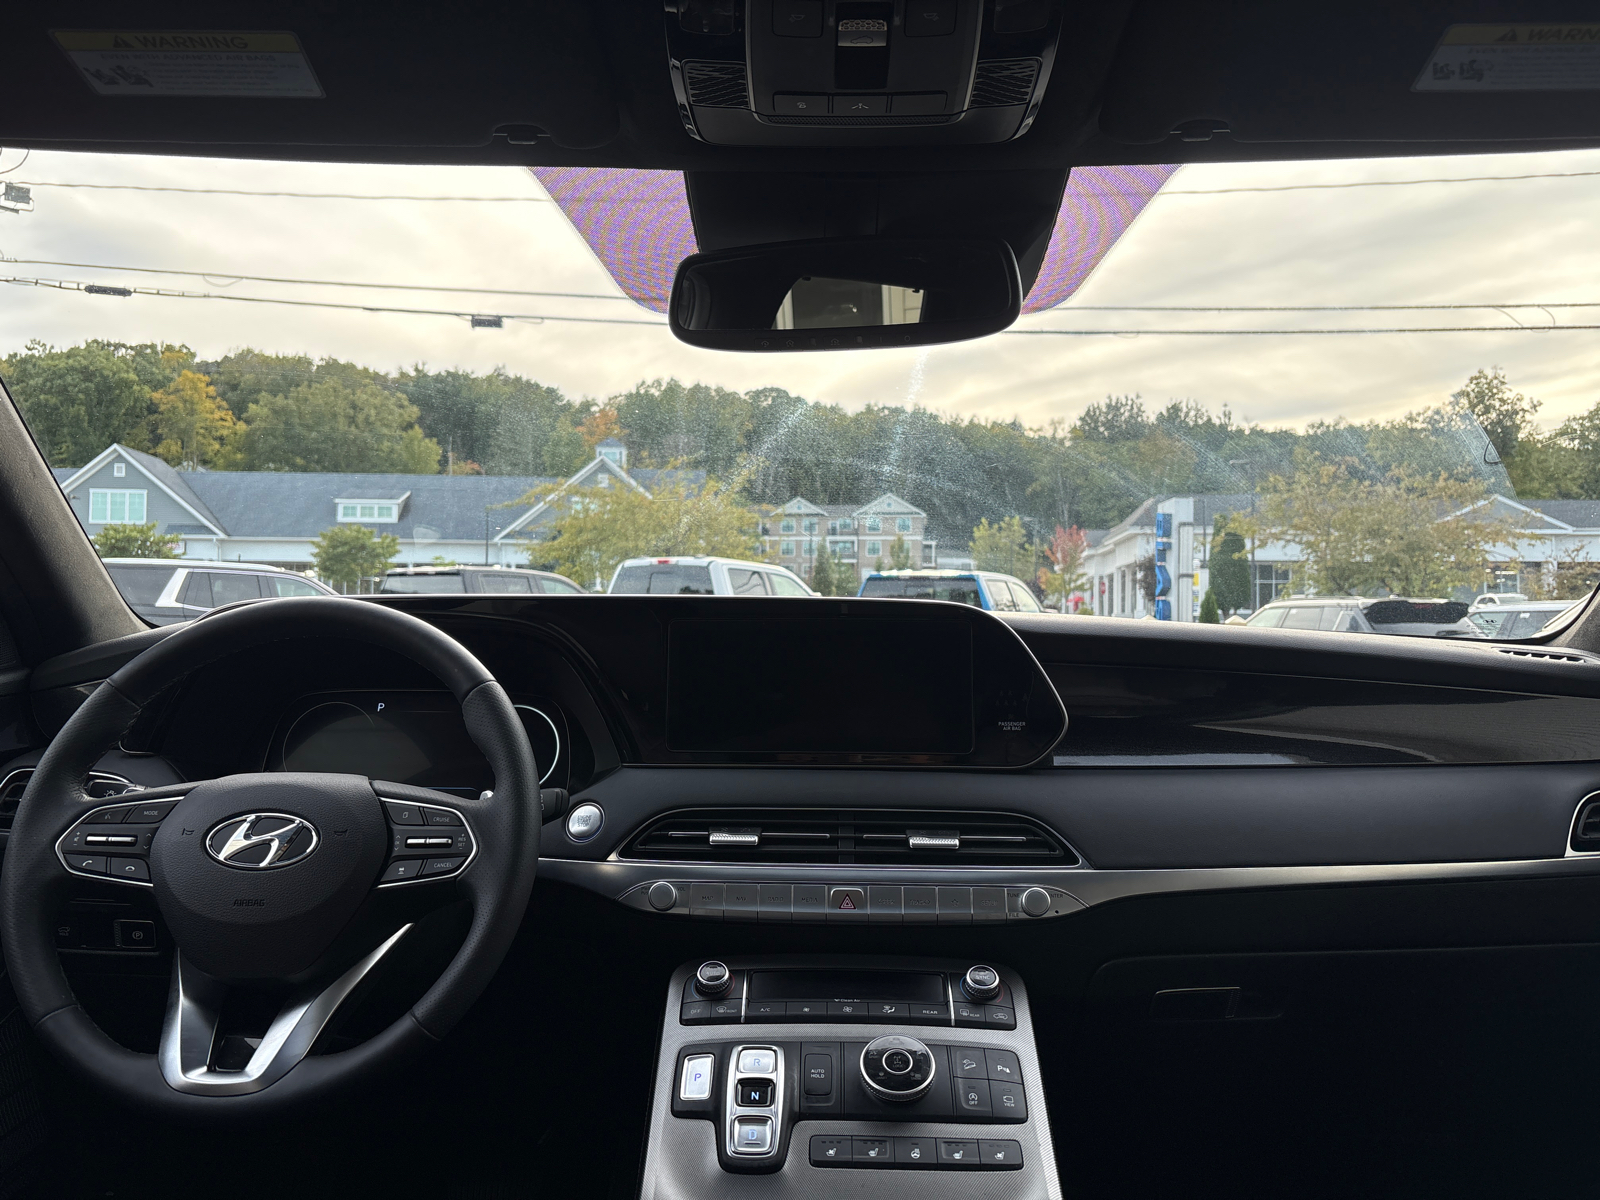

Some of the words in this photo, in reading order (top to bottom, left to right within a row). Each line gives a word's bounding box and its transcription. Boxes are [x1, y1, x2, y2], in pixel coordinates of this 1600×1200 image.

[134, 35, 248, 50] WARNING
[376, 702, 385, 712] P
[233, 899, 265, 907] AIRBAG
[753, 1058, 761, 1066] R
[694, 1072, 702, 1082] P
[750, 1091, 760, 1101] N
[748, 1128, 757, 1139] D
